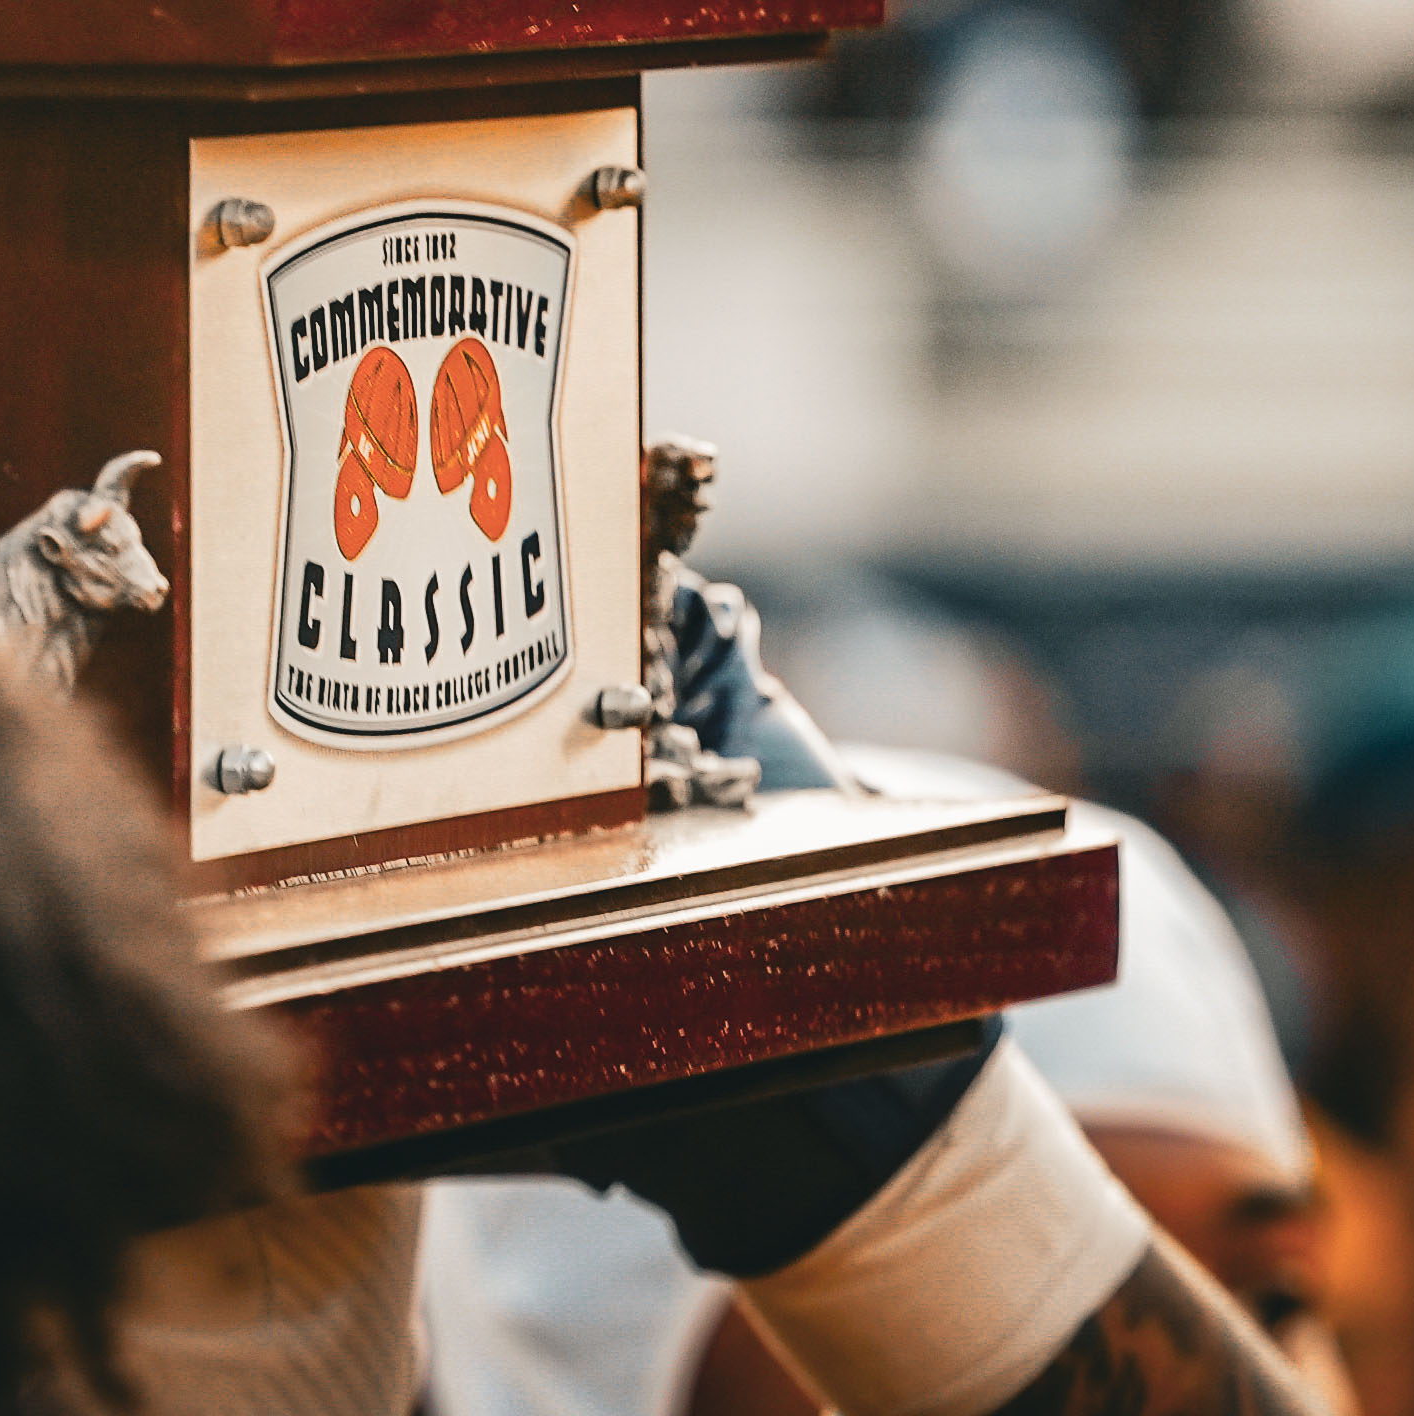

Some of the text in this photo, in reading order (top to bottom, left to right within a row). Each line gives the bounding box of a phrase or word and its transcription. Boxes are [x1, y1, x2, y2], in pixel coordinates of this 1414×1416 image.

[383, 232, 456, 266] SINCE 1892
[291, 275, 549, 382] COMMEMORATIVE
[298, 531, 545, 665] CLASSIC
[288, 632, 558, 715] THE BIRTH OF BLACK COLLEGE FOOTBALL
